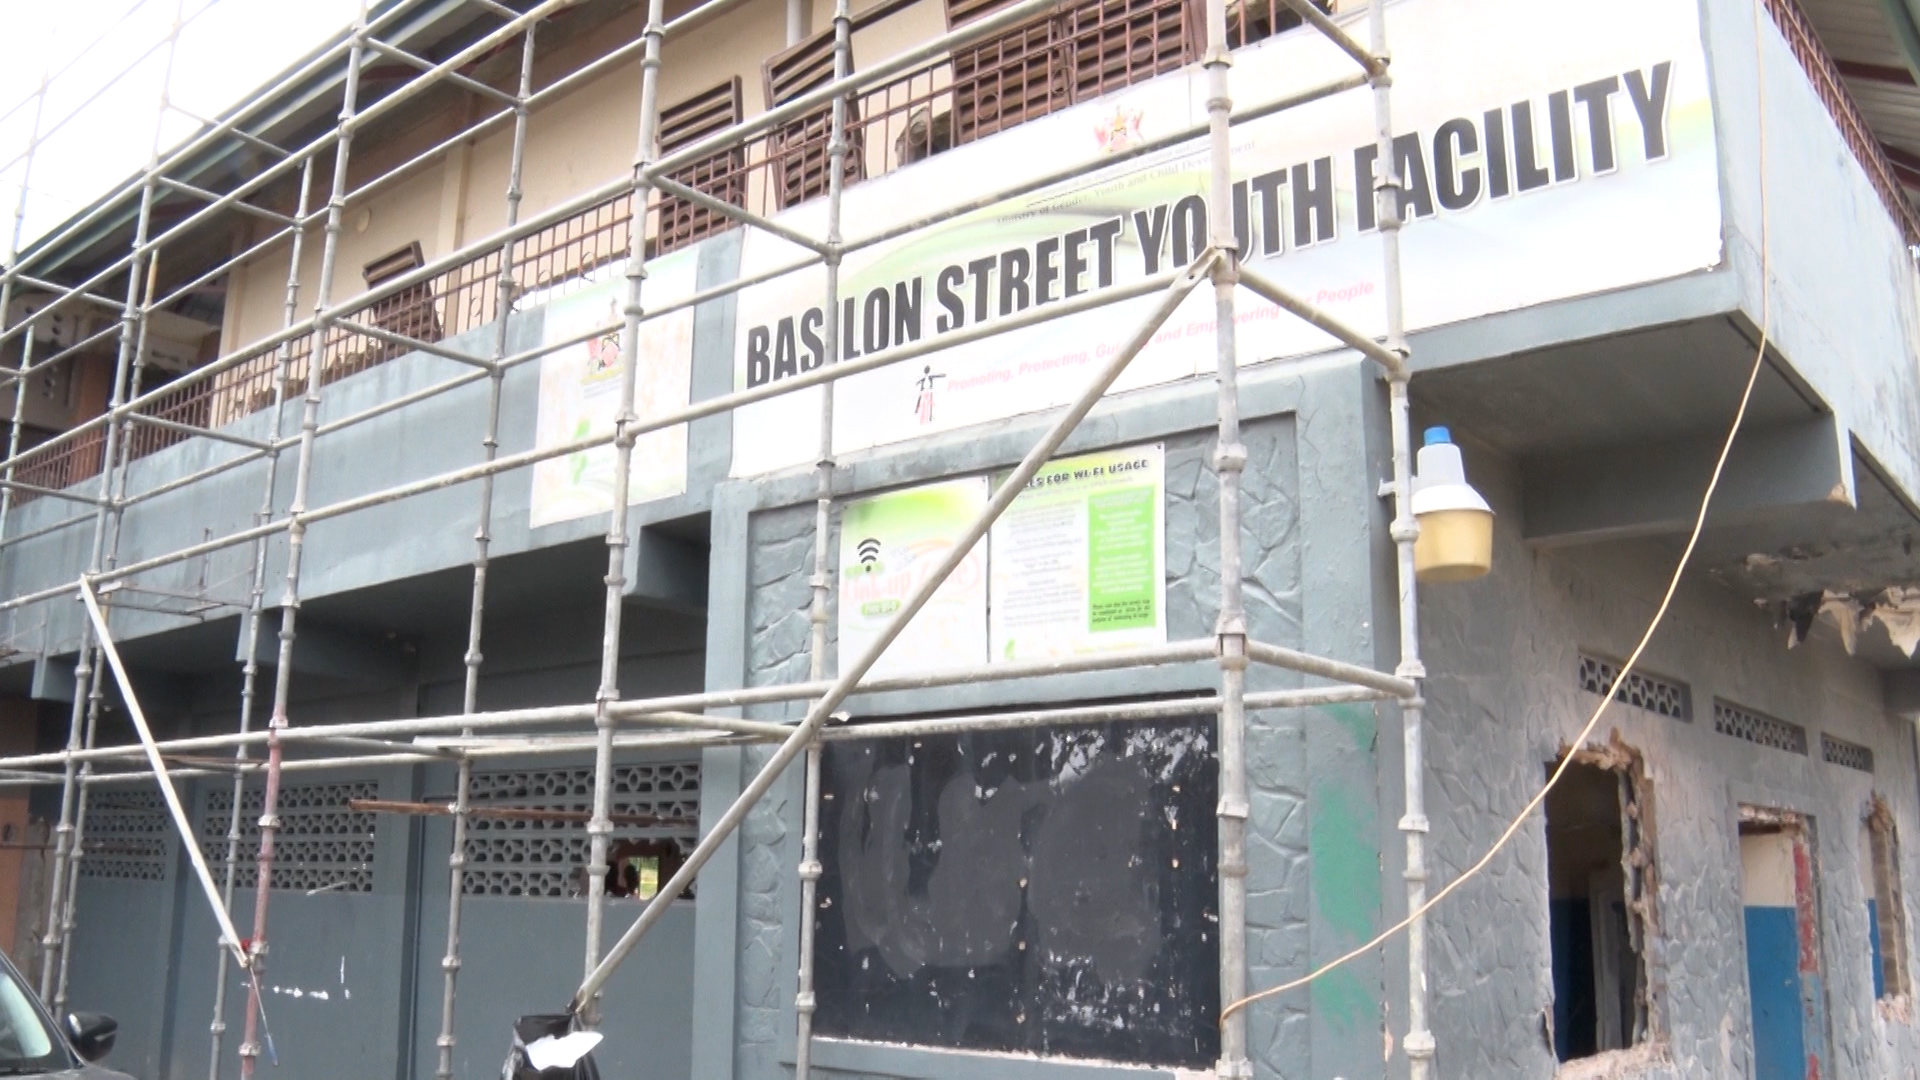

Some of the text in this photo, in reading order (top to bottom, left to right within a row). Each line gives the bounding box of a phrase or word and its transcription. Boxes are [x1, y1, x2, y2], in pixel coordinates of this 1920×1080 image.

[1094, 180, 1125, 197] Youth
[1127, 173, 1147, 188] and
[1149, 162, 1179, 180] Child
[1182, 141, 1256, 171] Devement
[747, 275, 922, 390] BASLON
[936, 217, 1121, 334] STREET
[1353, 59, 1673, 232] FACILITY
[1018, 350, 1091, 376] Protecting,
[1154, 325, 1182, 345] and
[1186, 304, 1281, 337] Empering
[1316, 279, 1375, 305] People
[1046, 472, 1070, 487] FOR
[1108, 458, 1150, 474] USAGE
